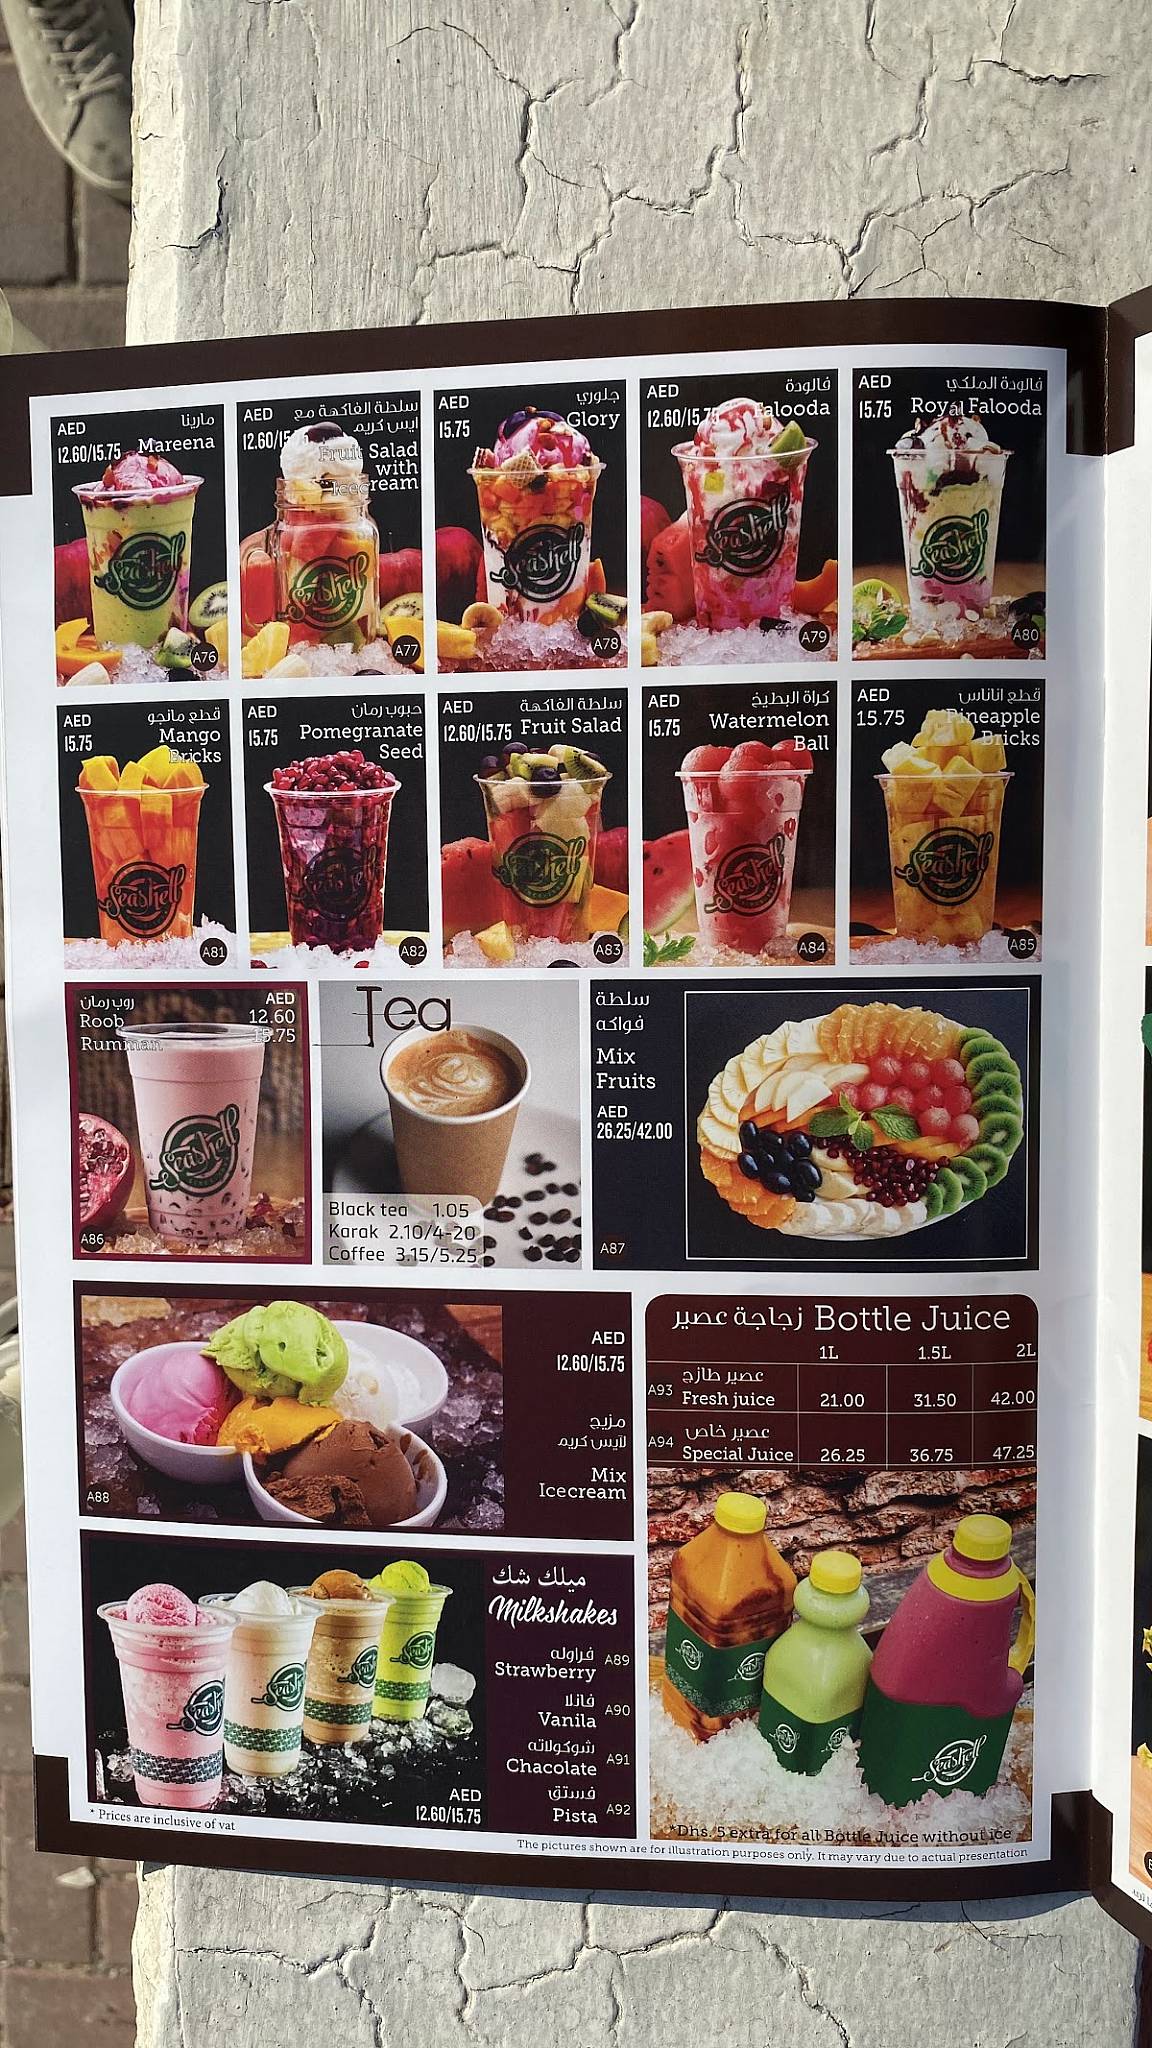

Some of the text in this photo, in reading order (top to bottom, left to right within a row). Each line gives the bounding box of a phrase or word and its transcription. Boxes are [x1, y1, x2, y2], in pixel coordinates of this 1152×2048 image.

[785, 376, 831, 395] فالودة
[858, 375, 891, 389] AED
[576, 388, 620, 405] جلوري
[647, 384, 679, 399] AED
[438, 395, 470, 410] AED
[754, 400, 831, 417] Falooda
[859, 400, 892, 419] 15.75
[911, 397, 1042, 417] Royal Falooda
[181, 413, 215, 430] مارينا
[243, 407, 273, 422] AED
[566, 411, 621, 430] Glory
[57, 422, 86, 436] AED
[439, 420, 470, 439] 15.75
[58, 443, 121, 464] 12.60/15.75
[138, 437, 216, 454] Mareena
[318, 441, 419, 462] Fruit Salad
[375, 459, 419, 476] with
[331, 477, 419, 497] Icecream
[800, 630, 828, 644] A79
[1013, 628, 1039, 641] A80
[395, 644, 419, 657] A77
[593, 638, 619, 651] A78
[193, 651, 217, 664] A76
[648, 694, 680, 708] AED
[752, 690, 830, 708] كراة البطيخ
[857, 688, 890, 702] AED
[247, 705, 277, 719] AED
[442, 700, 473, 714] AED
[519, 697, 623, 712] سلطة الفاكهة
[63, 714, 92, 728] AED
[148, 707, 221, 725] قطع مانجو
[709, 711, 830, 729] Watermelon
[856, 709, 905, 726] 15.75
[946, 708, 1041, 727] Pineapple
[299, 722, 423, 743] Pomegranate
[443, 722, 512, 743] 12.60/15.75
[520, 716, 622, 735] Fruit Salad
[648, 718, 681, 737] 15.75
[64, 734, 93, 752] 15.75
[159, 727, 221, 746] Mango
[249, 728, 278, 747] 15.75
[794, 735, 829, 751] Ball
[981, 730, 1040, 746] Bricks
[169, 749, 221, 764] Bricks
[379, 743, 424, 760] Seed
[201, 946, 226, 959] A81
[400, 945, 426, 958] A82
[596, 943, 621, 956] A83
[798, 941, 825, 954] A84
[1010, 939, 1035, 951] A85
[266, 993, 295, 1005] AED
[596, 991, 650, 1006] سلطة
[80, 1014, 124, 1028] Roob
[249, 1009, 295, 1024] 12.60
[352, 985, 451, 1047] Tea
[596, 1015, 644, 1034] فواكه
[81, 1037, 163, 1051] Rumman
[252, 1029, 296, 1043] 15.75
[596, 1048, 636, 1065] Mix
[596, 1073, 656, 1089] Fruits
[597, 1106, 628, 1118] AED
[597, 1122, 673, 1140] 26.25/42.00
[329, 1201, 469, 1218] Black tea 1.05
[80, 1233, 104, 1245] A86
[329, 1224, 476, 1240] Karak 2.10/4-20
[329, 1246, 477, 1263] Coffee 3.15/5.25
[600, 1243, 625, 1254] A87
[672, 1306, 803, 1331] زجاجة عصير
[814, 1304, 1010, 1331] Bottle Juice
[591, 1331, 625, 1345] AED
[819, 1344, 1036, 1360] 1L 1.5L 2L
[557, 1354, 625, 1373] 12.60/15.75
[682, 1367, 764, 1385] عصير طازج
[648, 1384, 1035, 1408] A93 Fresh juice 21.00 31.50 42.00
[590, 1413, 626, 1430] مزيج
[648, 1436, 1034, 1463] A94 Special Juice 26.25 36.75 47.25
[591, 1467, 627, 1483] Mix
[87, 1491, 110, 1503] A88
[539, 1482, 627, 1500] Icecream
[492, 1565, 586, 1592] ميلك شك
[488, 1595, 617, 1629] Milkshakes
[551, 1647, 594, 1663] فراوله
[605, 1654, 629, 1665] A89
[495, 1662, 596, 1682] Strawberry
[605, 1705, 630, 1716] A90
[538, 1712, 596, 1728] Vanila
[507, 1758, 596, 1776] Chacolate
[607, 1754, 630, 1765] A91
[450, 1788, 481, 1801] AED
[416, 1805, 481, 1824] 12.60/15.75
[553, 1808, 597, 1824] Pista
[607, 1804, 631, 1815] A92
[98, 1809, 131, 1821] Prices
[154, 1814, 201, 1828] inclusive
[205, 1818, 217, 1829] of
[219, 1821, 235, 1830] vat
[717, 1826, 726, 1838] 5
[730, 1828, 770, 1839] extra
[775, 1828, 798, 1841] for
[801, 1829, 821, 1842] all
[824, 1829, 871, 1842] Bottle
[875, 1830, 919, 1843] Juice
[922, 1829, 986, 1843] without
[989, 1828, 1012, 1840] ice
[517, 1839, 1028, 1864] The pictures shown are for illustration purposes only. It may vary due to actual presentation
